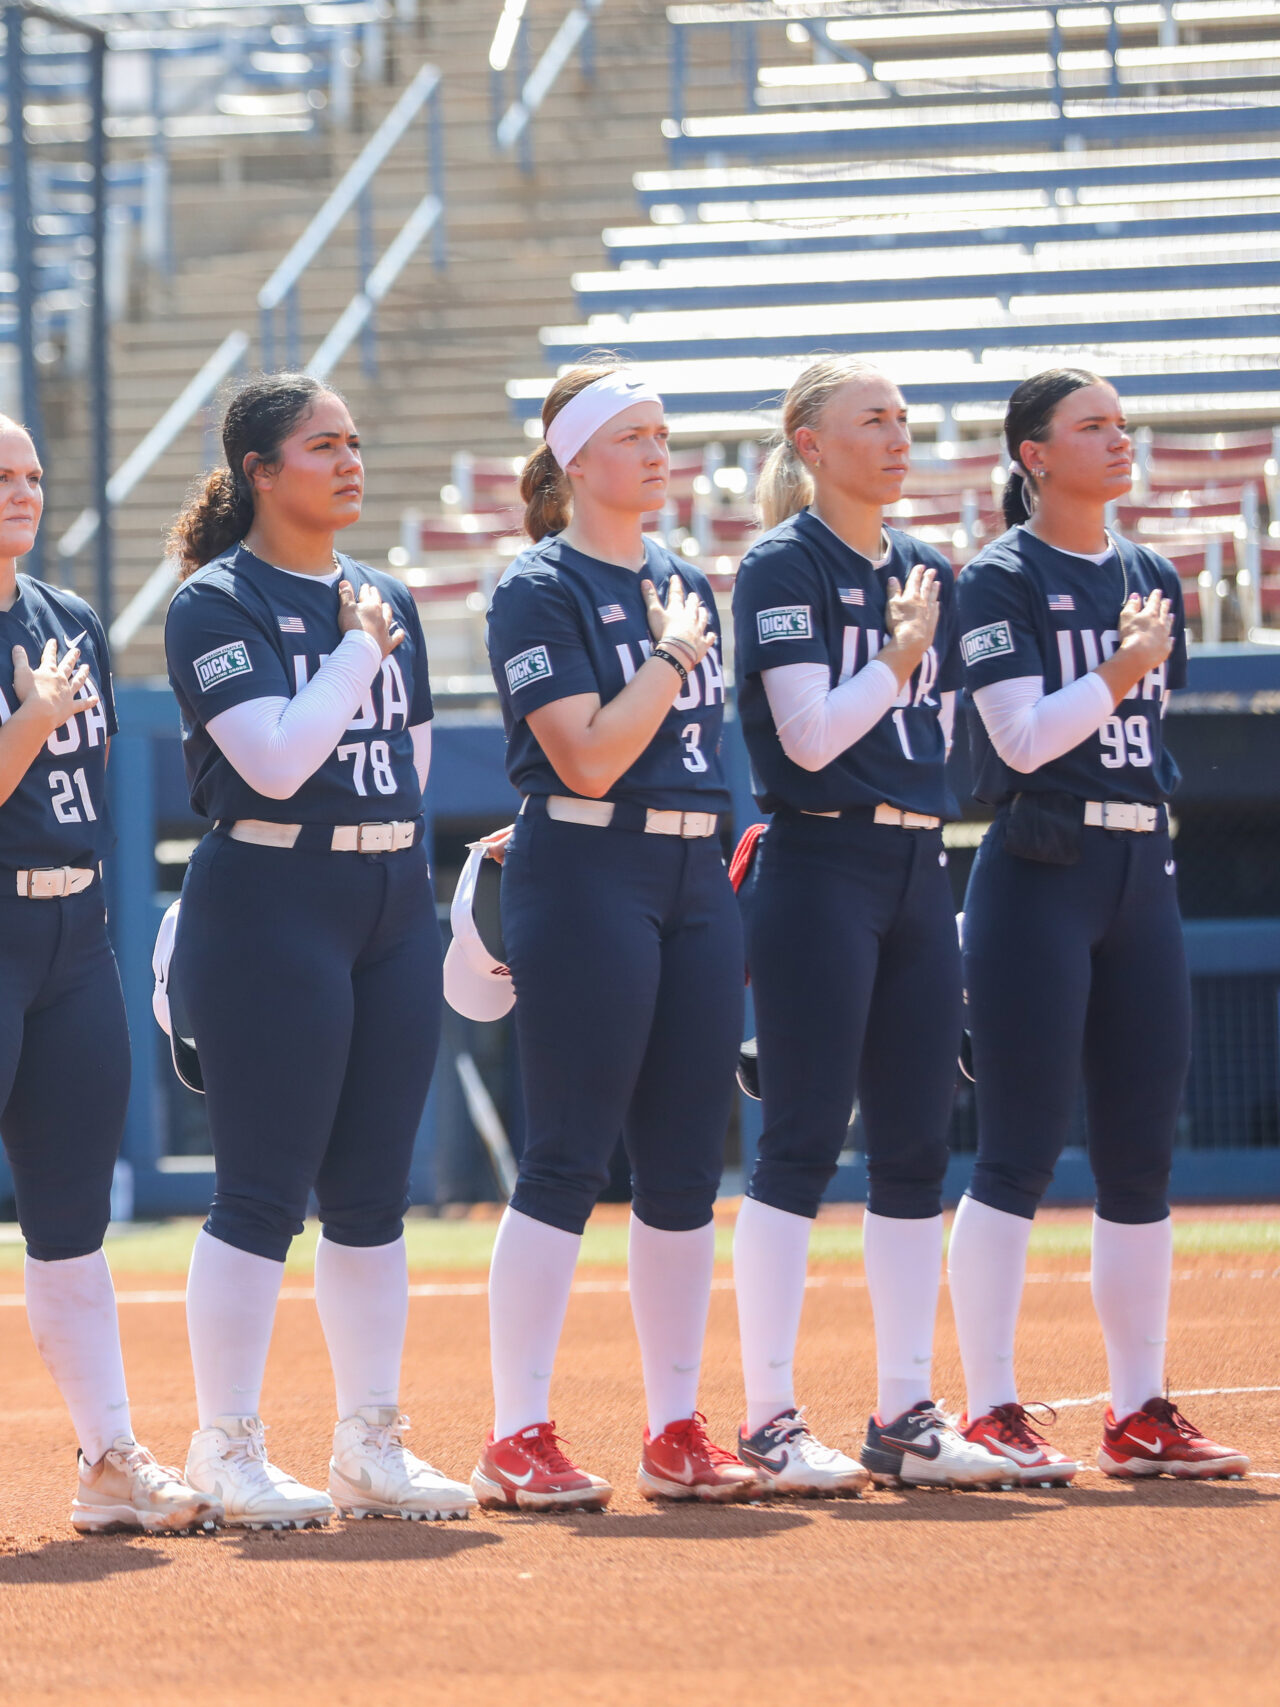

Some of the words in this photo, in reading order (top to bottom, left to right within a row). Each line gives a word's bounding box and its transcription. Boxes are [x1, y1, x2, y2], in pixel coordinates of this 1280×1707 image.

[761, 614, 807, 635] DICK'S
[966, 629, 1008, 656] DICK'S
[200, 650, 246, 681] DICK'S
[205, 671, 228, 685] SPORTING
[228, 665, 248, 673] GOODS
[508, 654, 546, 685] DICK'S
[681, 723, 708, 773] 3
[892, 709, 915, 760] 1
[1099, 715, 1152, 768] 99
[337, 740, 398, 796] 78
[48, 768, 97, 824] 21
